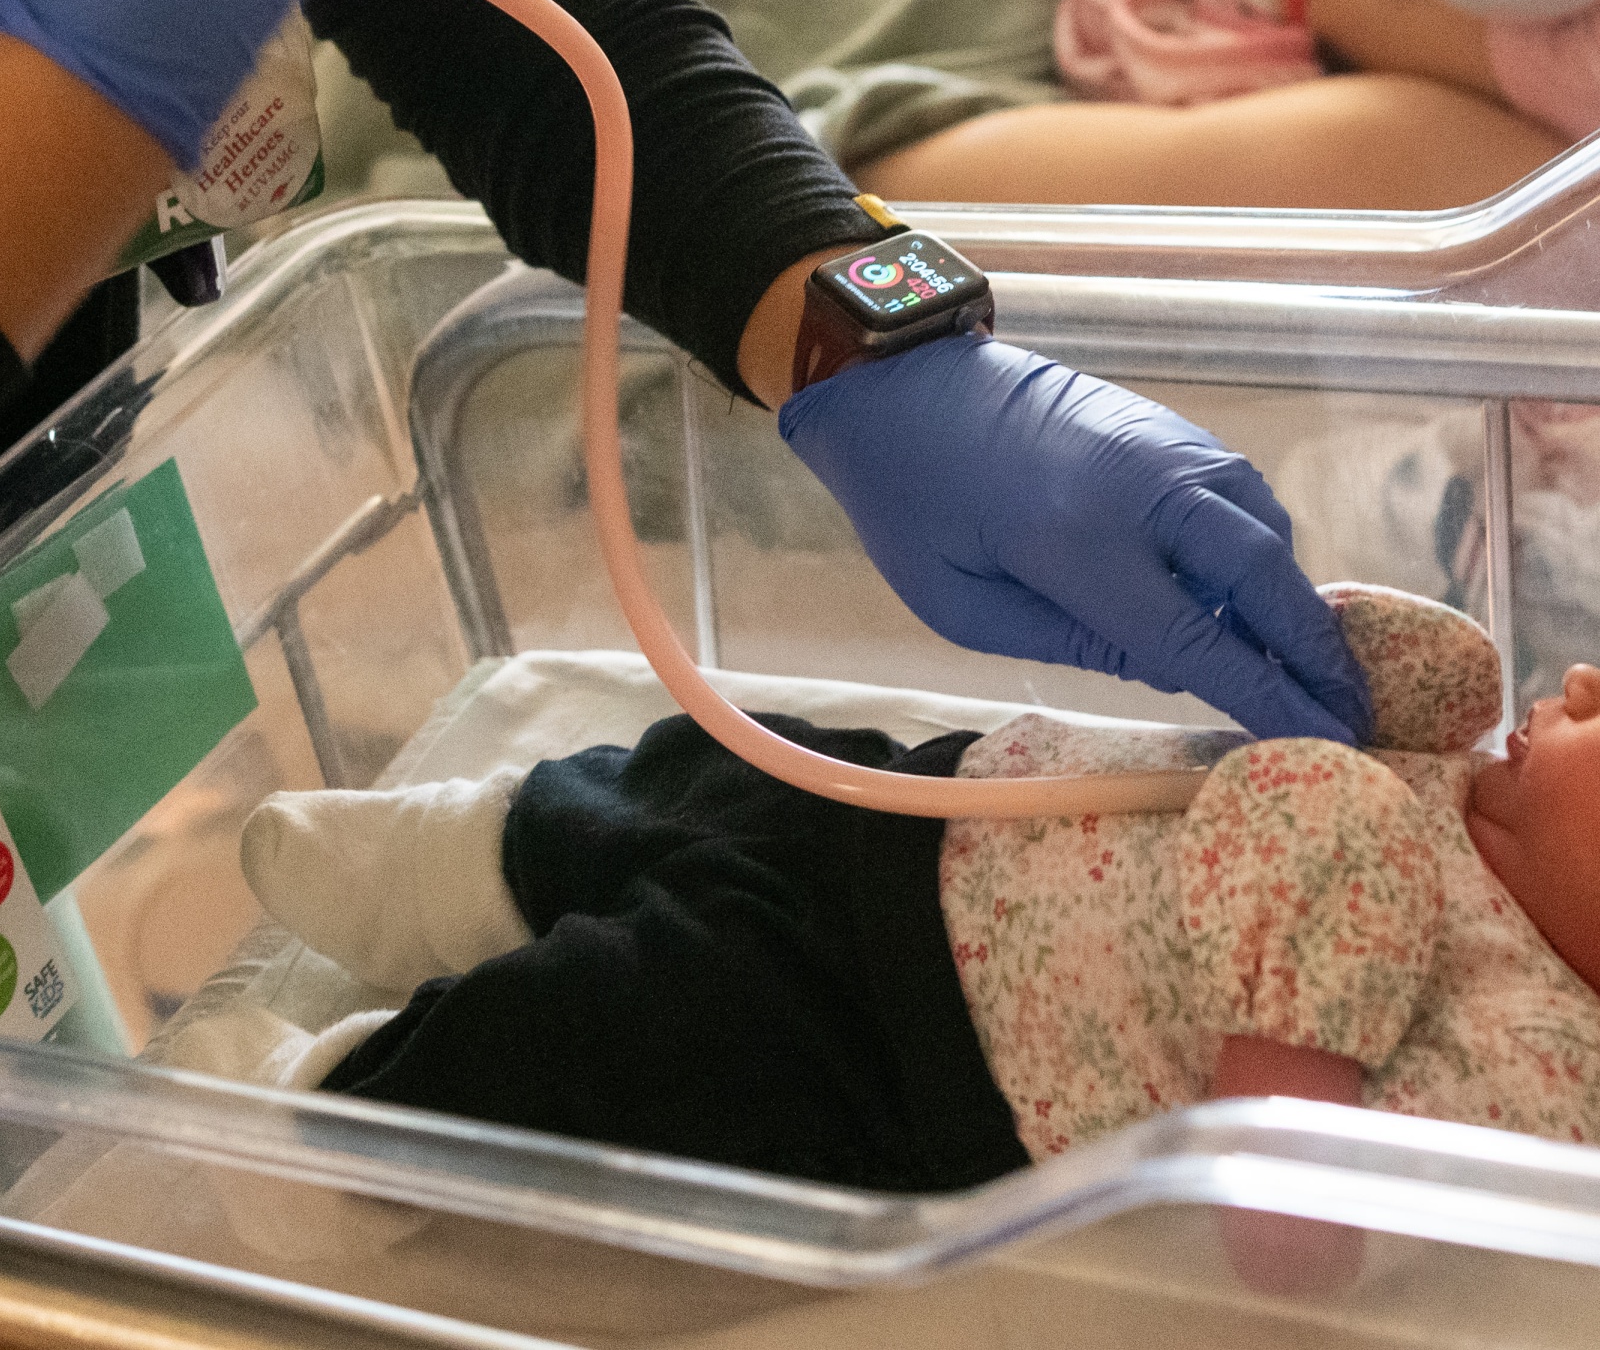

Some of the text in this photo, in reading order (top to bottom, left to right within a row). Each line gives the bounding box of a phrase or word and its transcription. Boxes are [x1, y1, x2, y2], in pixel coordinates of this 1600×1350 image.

[230, 101, 251, 124] our
[198, 96, 284, 194] Healthcare
[224, 129, 285, 194] Heroes
[898, 252, 954, 294] 2:04:56
[884, 298, 905, 313] 11
[901, 292, 921, 307] 11
[24, 959, 58, 1001] SAFE
[30, 976, 64, 1017] KIDS
